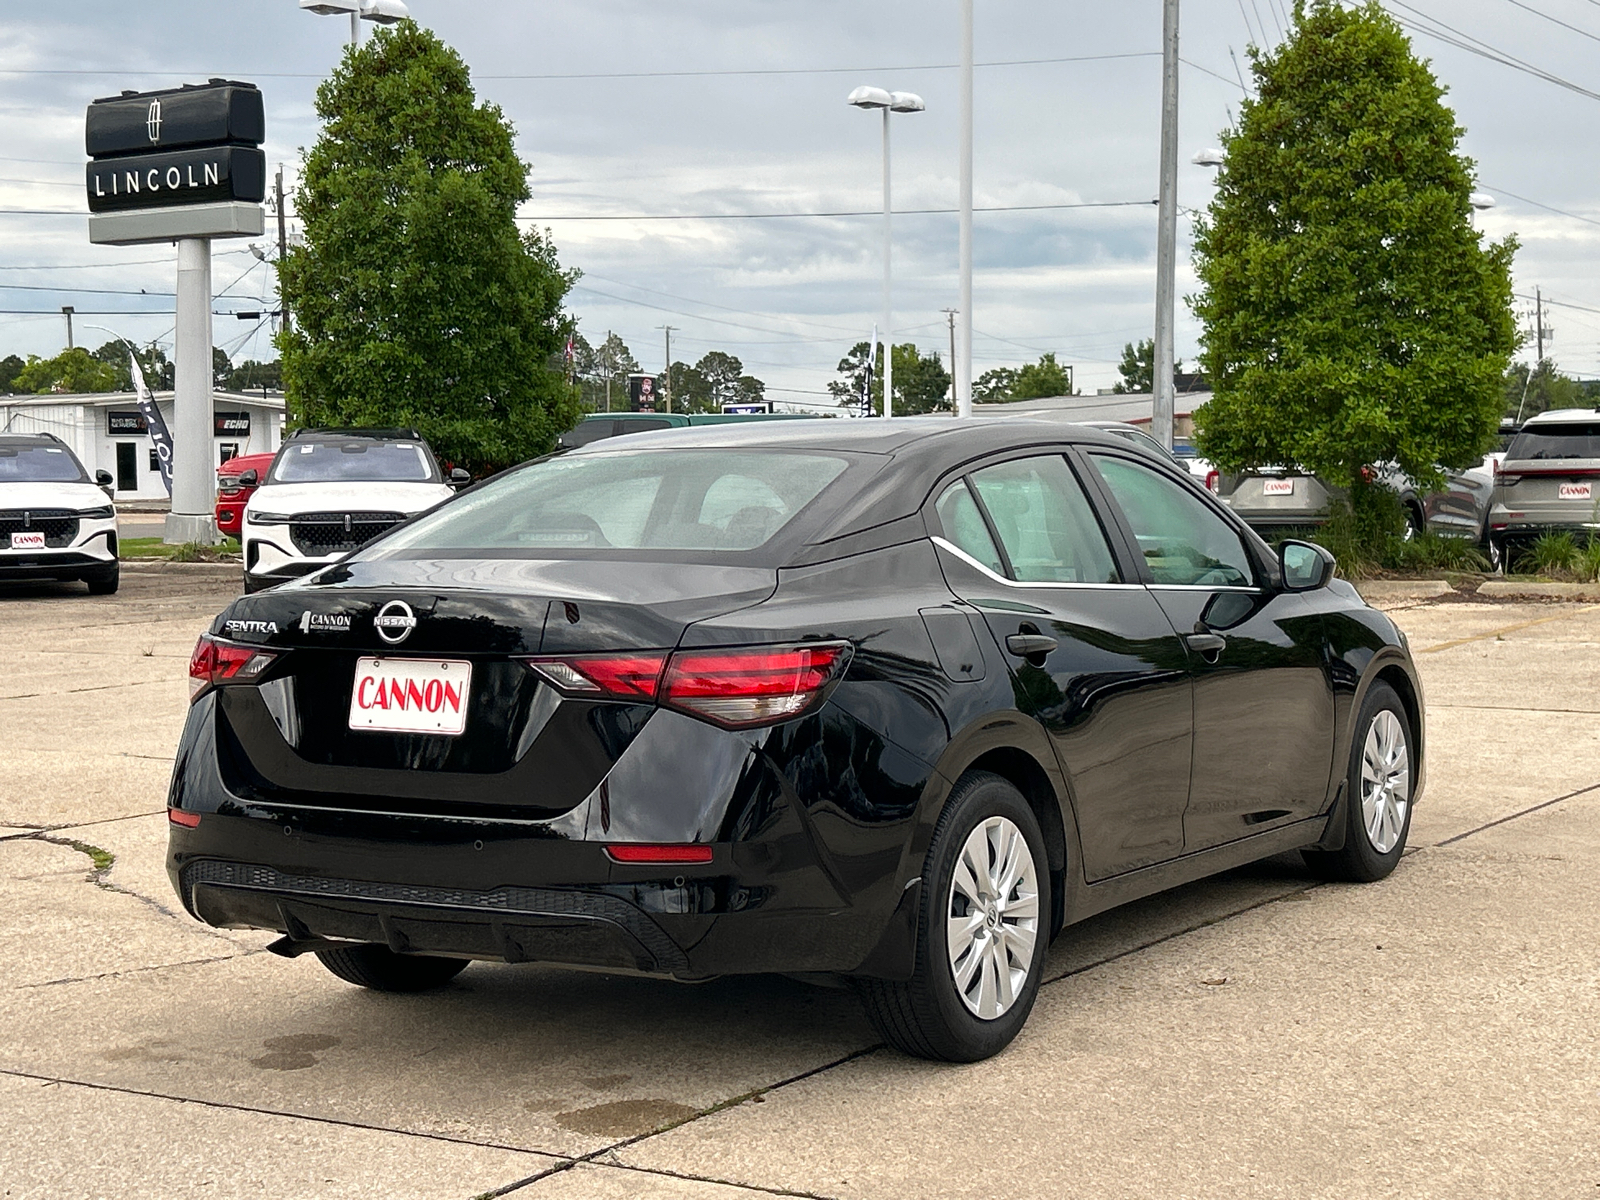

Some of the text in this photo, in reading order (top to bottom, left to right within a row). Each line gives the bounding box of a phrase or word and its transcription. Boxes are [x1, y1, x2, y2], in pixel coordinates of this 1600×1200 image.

[95, 162, 219, 197] LINCOLN
[223, 419, 249, 430] ECHO
[1265, 483, 1291, 491] CANNON
[1560, 486, 1590, 496] CANNON
[13, 535, 43, 544] CANNON
[311, 614, 351, 626] CANNON
[374, 616, 416, 627] NISSAN
[225, 620, 278, 634] SENTRA
[358, 676, 463, 714] CANNON
